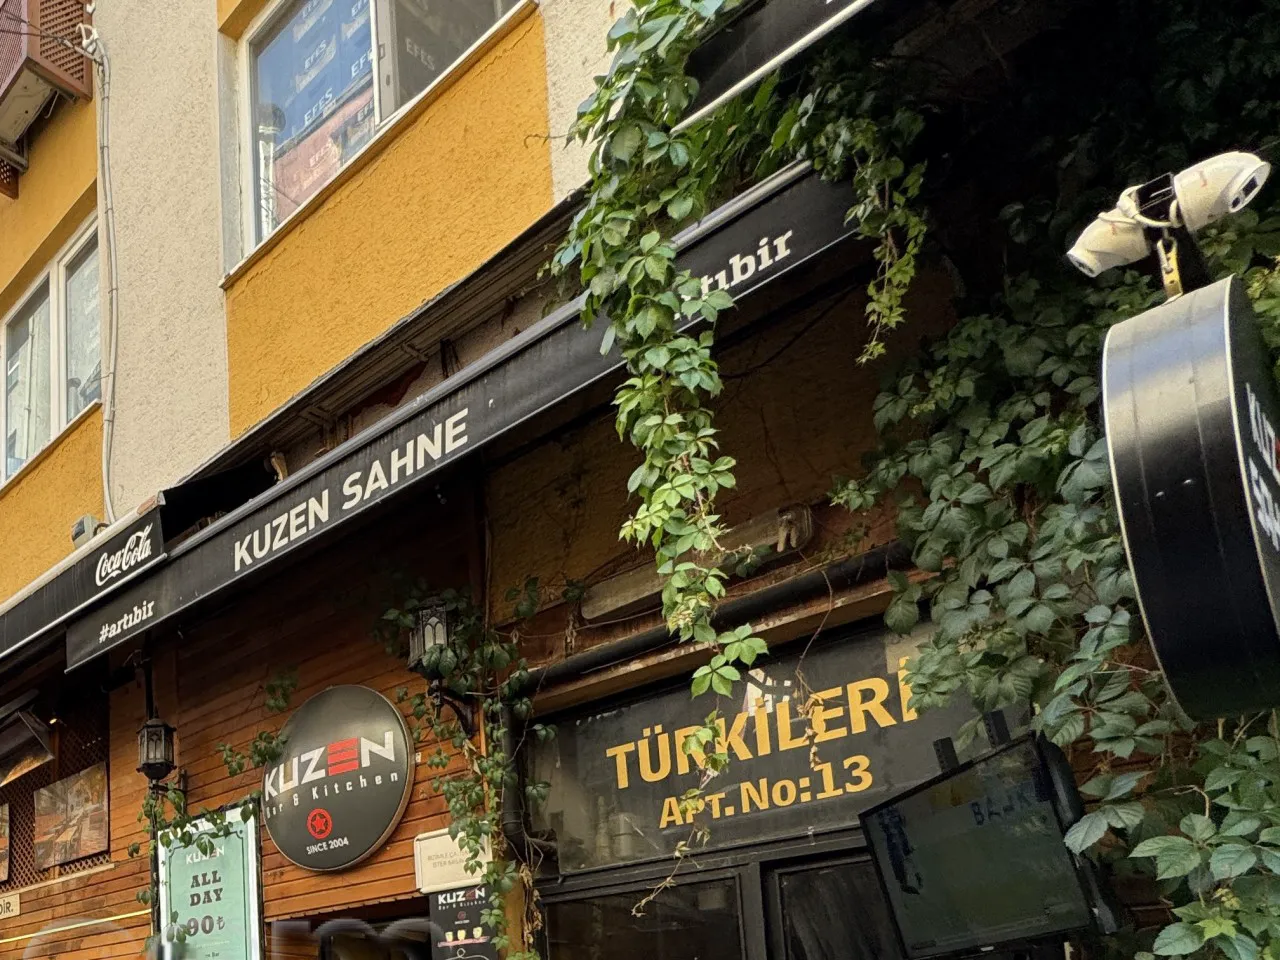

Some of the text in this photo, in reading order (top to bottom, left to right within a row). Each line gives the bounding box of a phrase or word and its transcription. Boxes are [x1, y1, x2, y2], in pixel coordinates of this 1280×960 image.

[304, 87, 333, 126] EFES
[234, 407, 469, 572] KUZEN SAHNE
[98, 599, 155, 644] #artıbir
[264, 730, 396, 802] KUZEN
[292, 793, 299, 806] &
[312, 772, 399, 800] Kitchen
[306, 836, 350, 855] SINCE 2004
[189, 887, 224, 907] DAY
[190, 870, 222, 889] ALL
